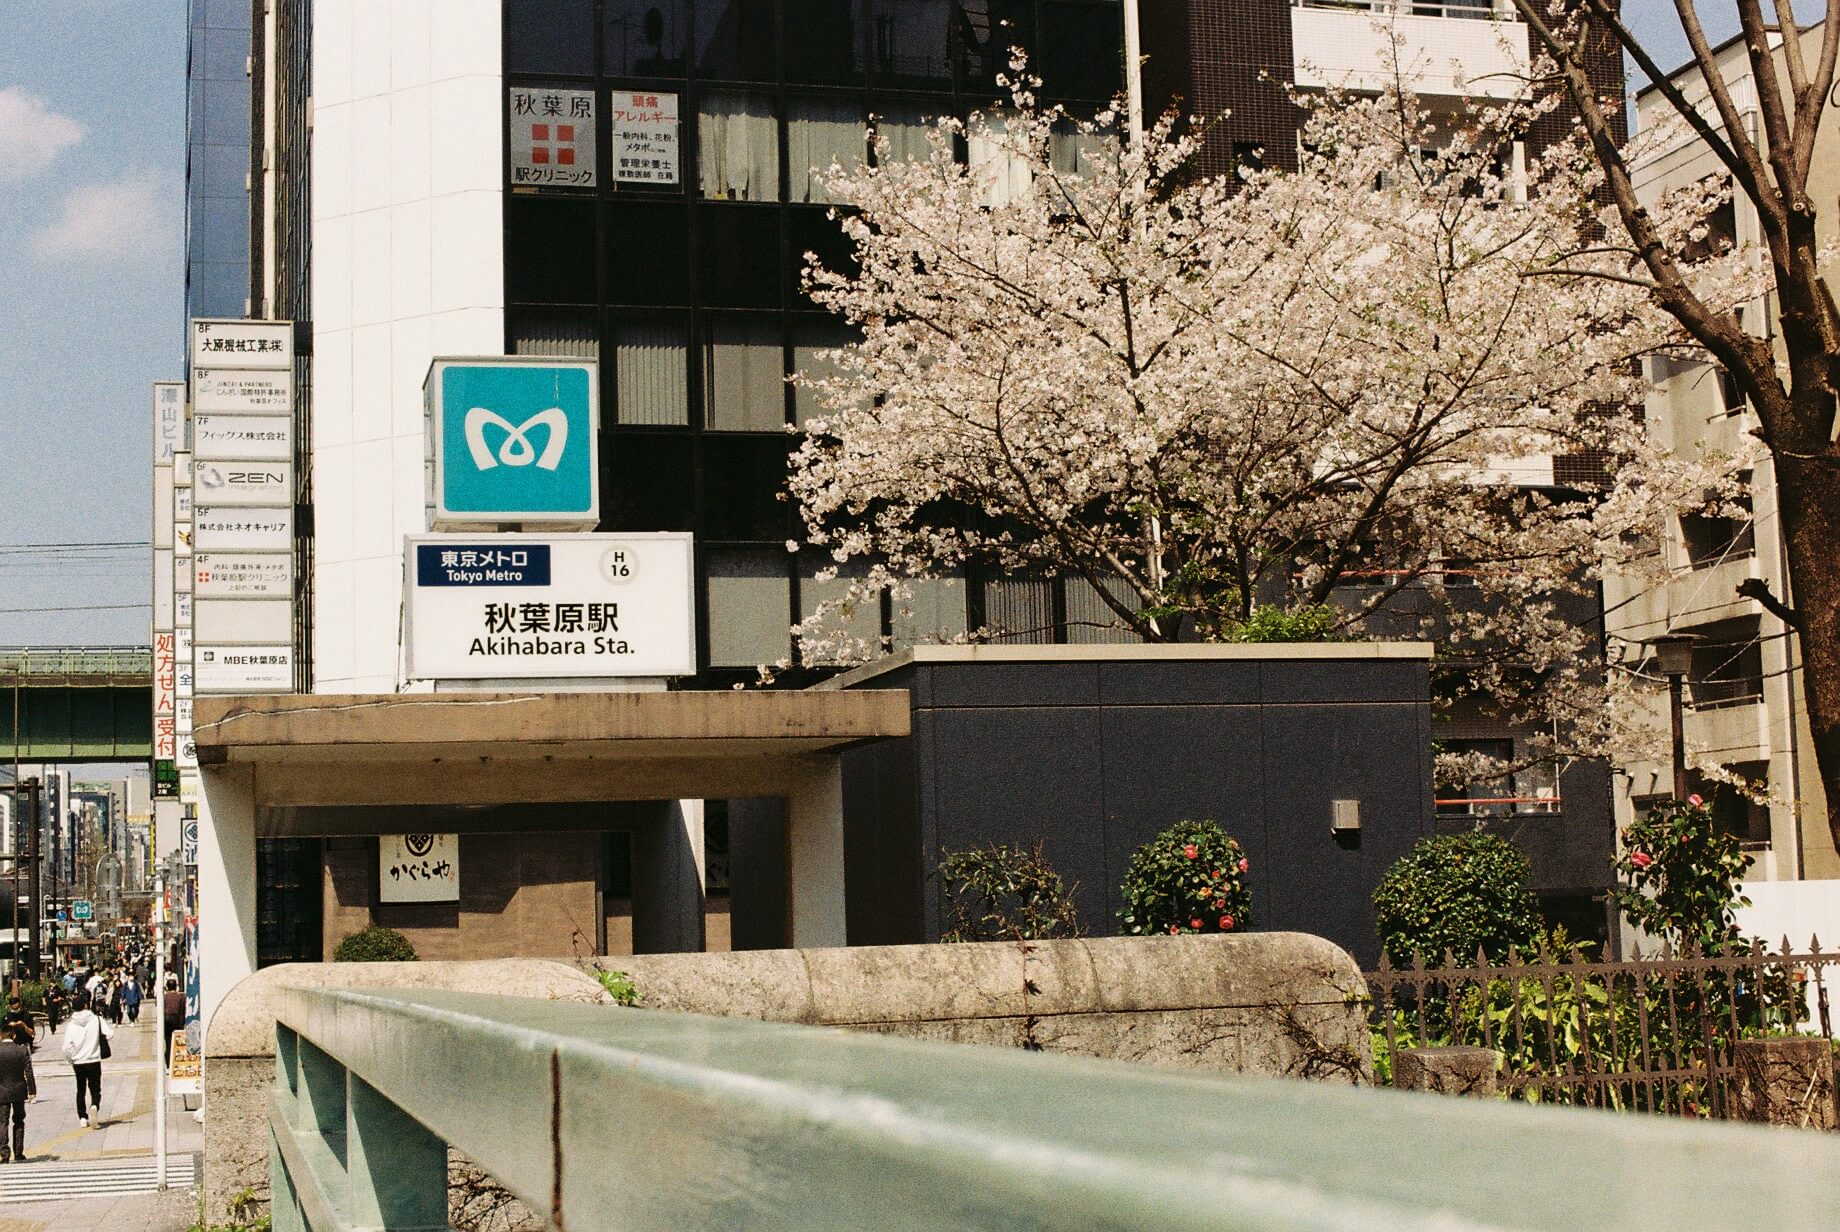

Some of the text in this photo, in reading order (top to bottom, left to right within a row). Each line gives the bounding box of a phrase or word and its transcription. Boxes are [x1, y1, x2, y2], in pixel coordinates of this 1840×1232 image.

[514, 93, 592, 118] 秋葉原
[632, 95, 659, 108] 頭痛
[614, 110, 677, 122] アレルギー
[515, 167, 593, 184] 駅クリニック
[198, 324, 211, 333] 8F
[197, 371, 209, 379] 8F
[197, 418, 209, 426] 7F
[200, 431, 287, 441] フィックス株式会社
[196, 462, 207, 471] 6F
[228, 472, 284, 484] ZEN
[197, 507, 210, 516] 5F
[199, 523, 286, 532] 株式会社ネオキャリア
[197, 555, 209, 563] 4F
[441, 550, 528, 568] 東京メトロ
[614, 551, 625, 563] H
[446, 569, 523, 583] Tokyo Metro
[611, 564, 630, 577] 16
[484, 602, 619, 633] 秋葉原駅
[469, 636, 635, 656] Akihabara Sta.
[223, 656, 289, 665] MBE秋葉原店
